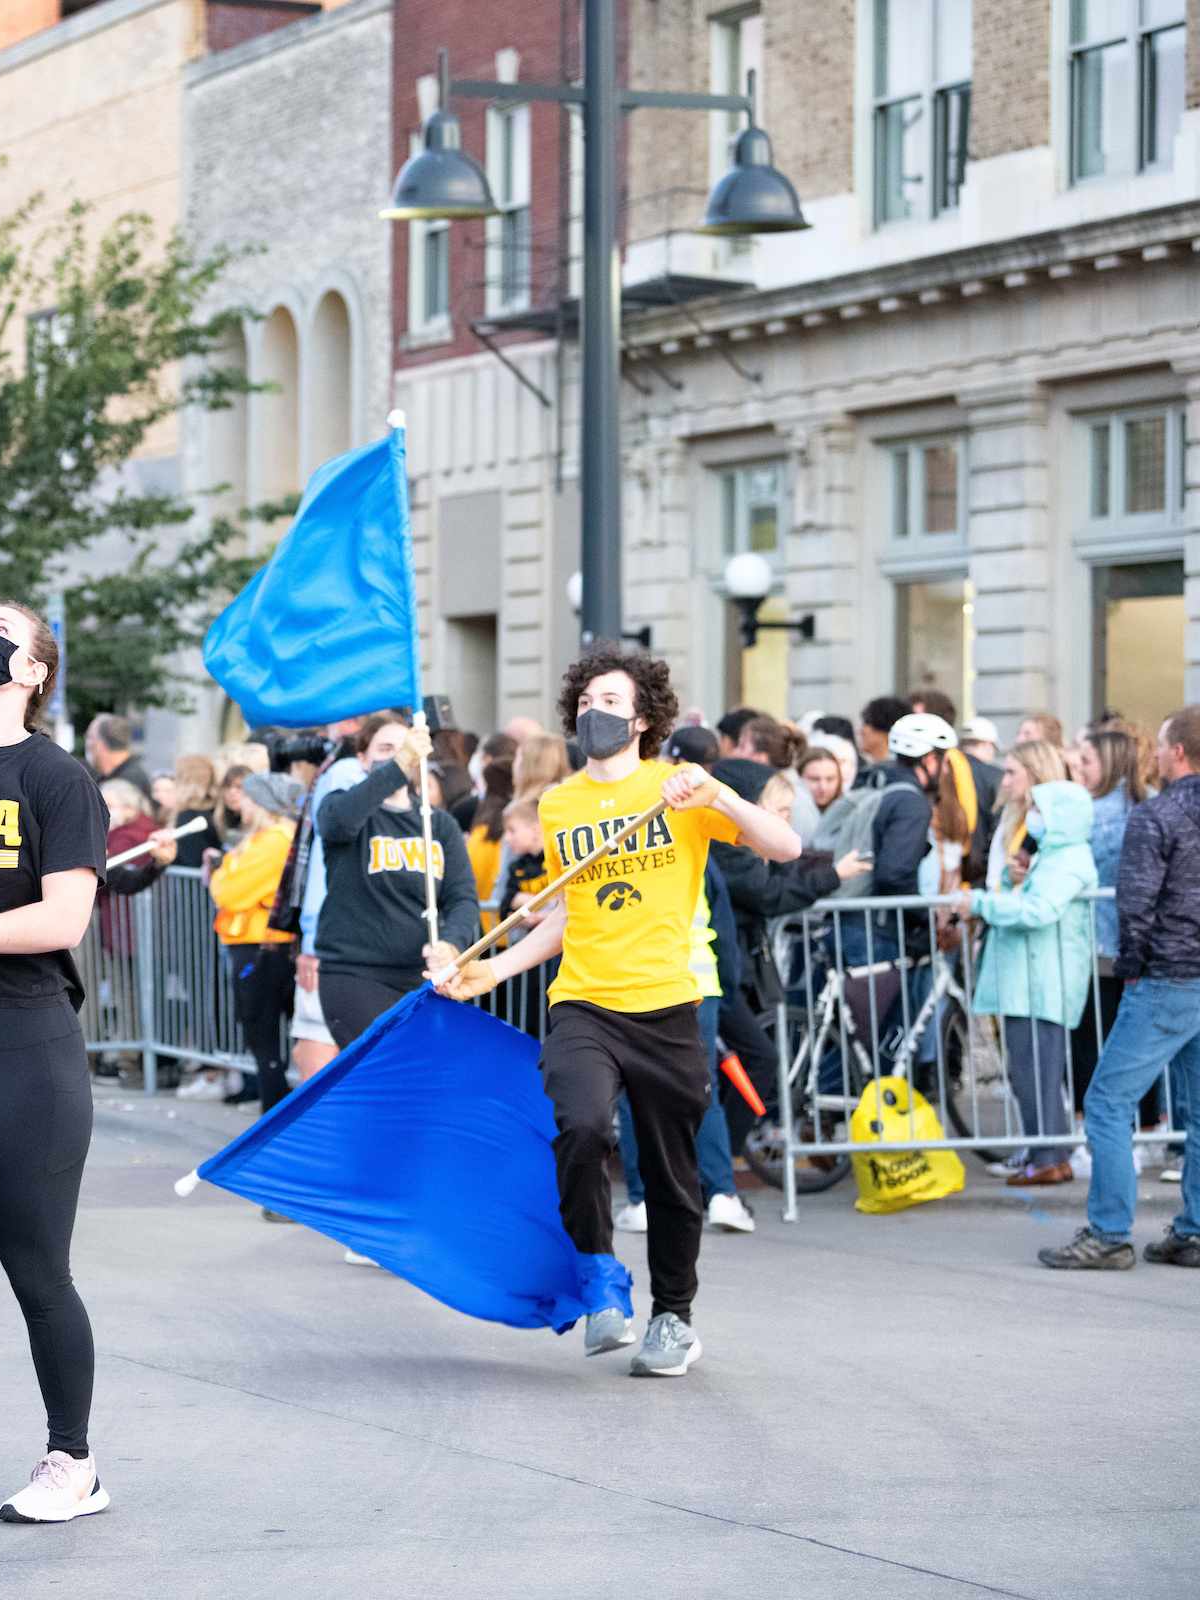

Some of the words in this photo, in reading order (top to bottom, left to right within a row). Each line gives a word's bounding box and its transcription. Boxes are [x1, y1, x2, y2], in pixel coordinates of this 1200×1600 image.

[367, 835, 445, 881] IOWA
[555, 808, 674, 869] IOWA
[570, 848, 676, 885] AWKEYES
